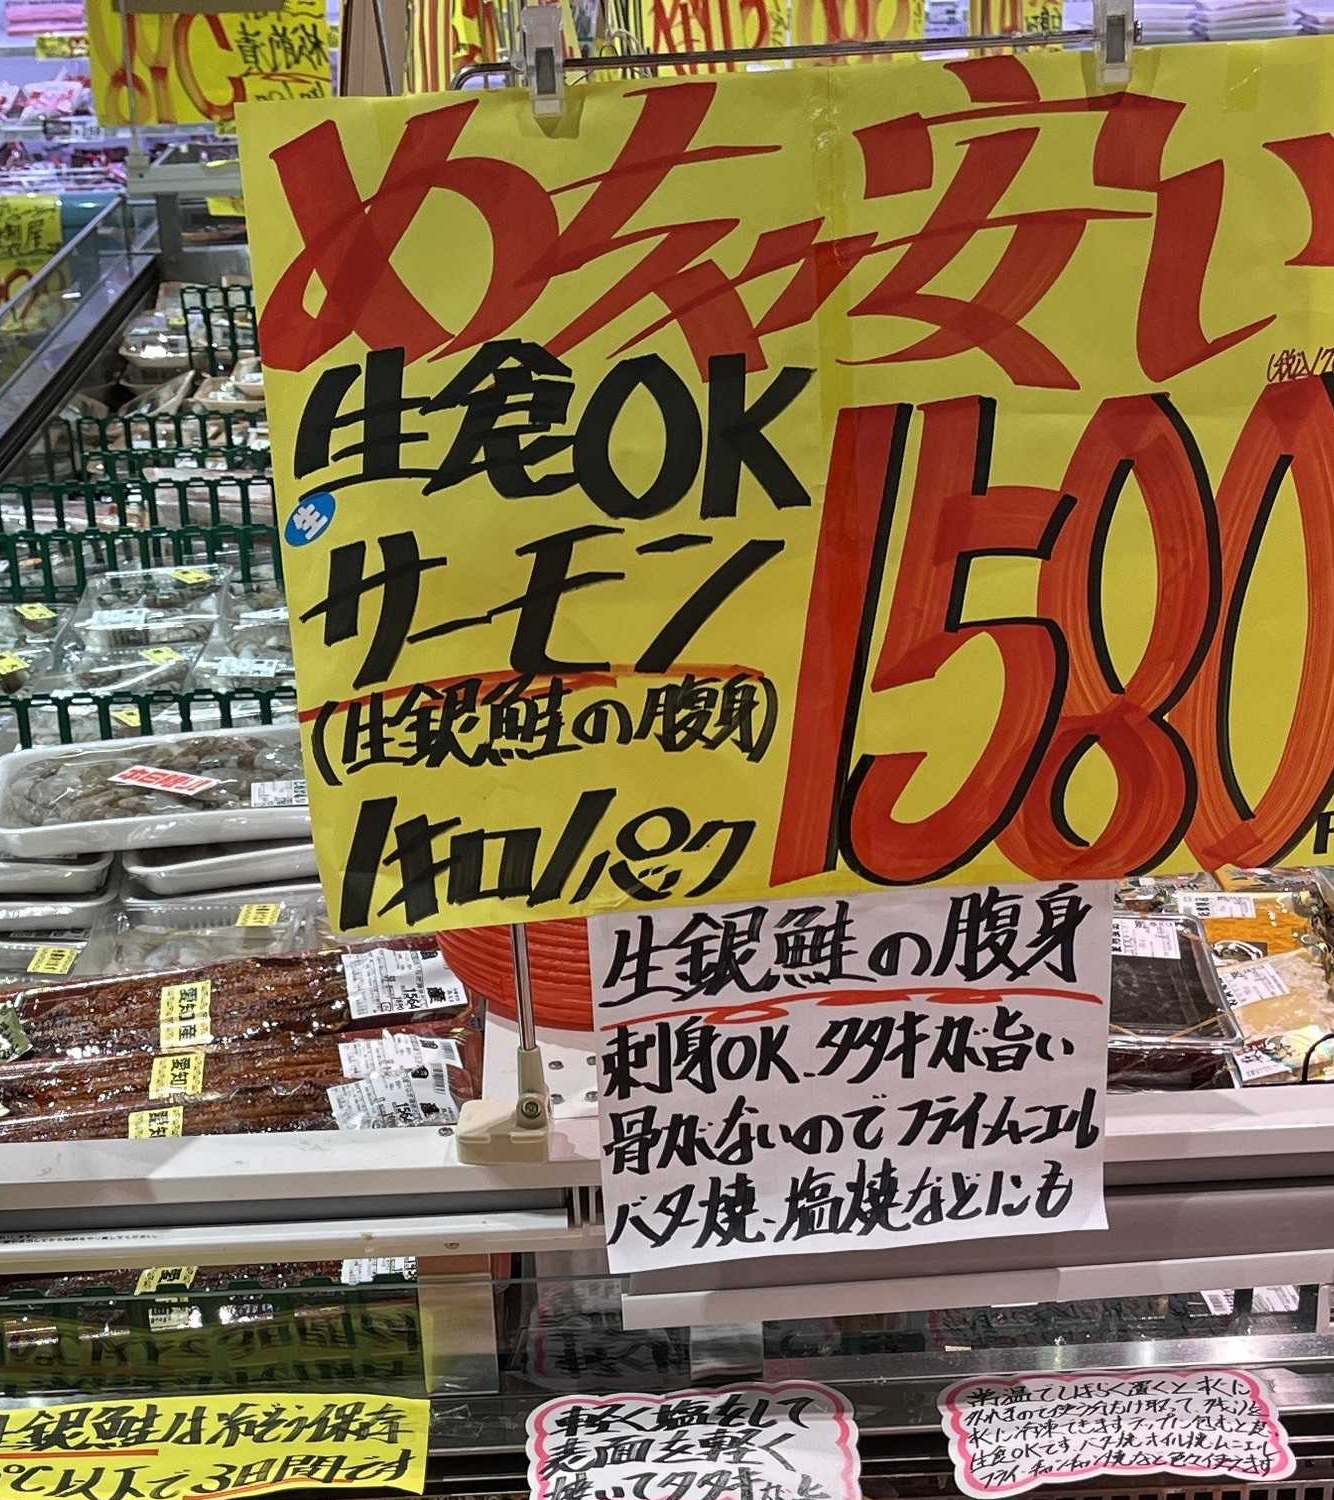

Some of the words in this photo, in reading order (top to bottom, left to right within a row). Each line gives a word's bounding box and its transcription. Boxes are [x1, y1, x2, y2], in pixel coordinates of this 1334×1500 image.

[294, 338, 818, 520] 生食OK
[300, 524, 786, 688] サーモン
[311, 672, 779, 786] (生銀鮭の腹身)
[599, 883, 1093, 1008] 生銀鮭の腹身
[539, 1428, 797, 1481] 表面を軽く
